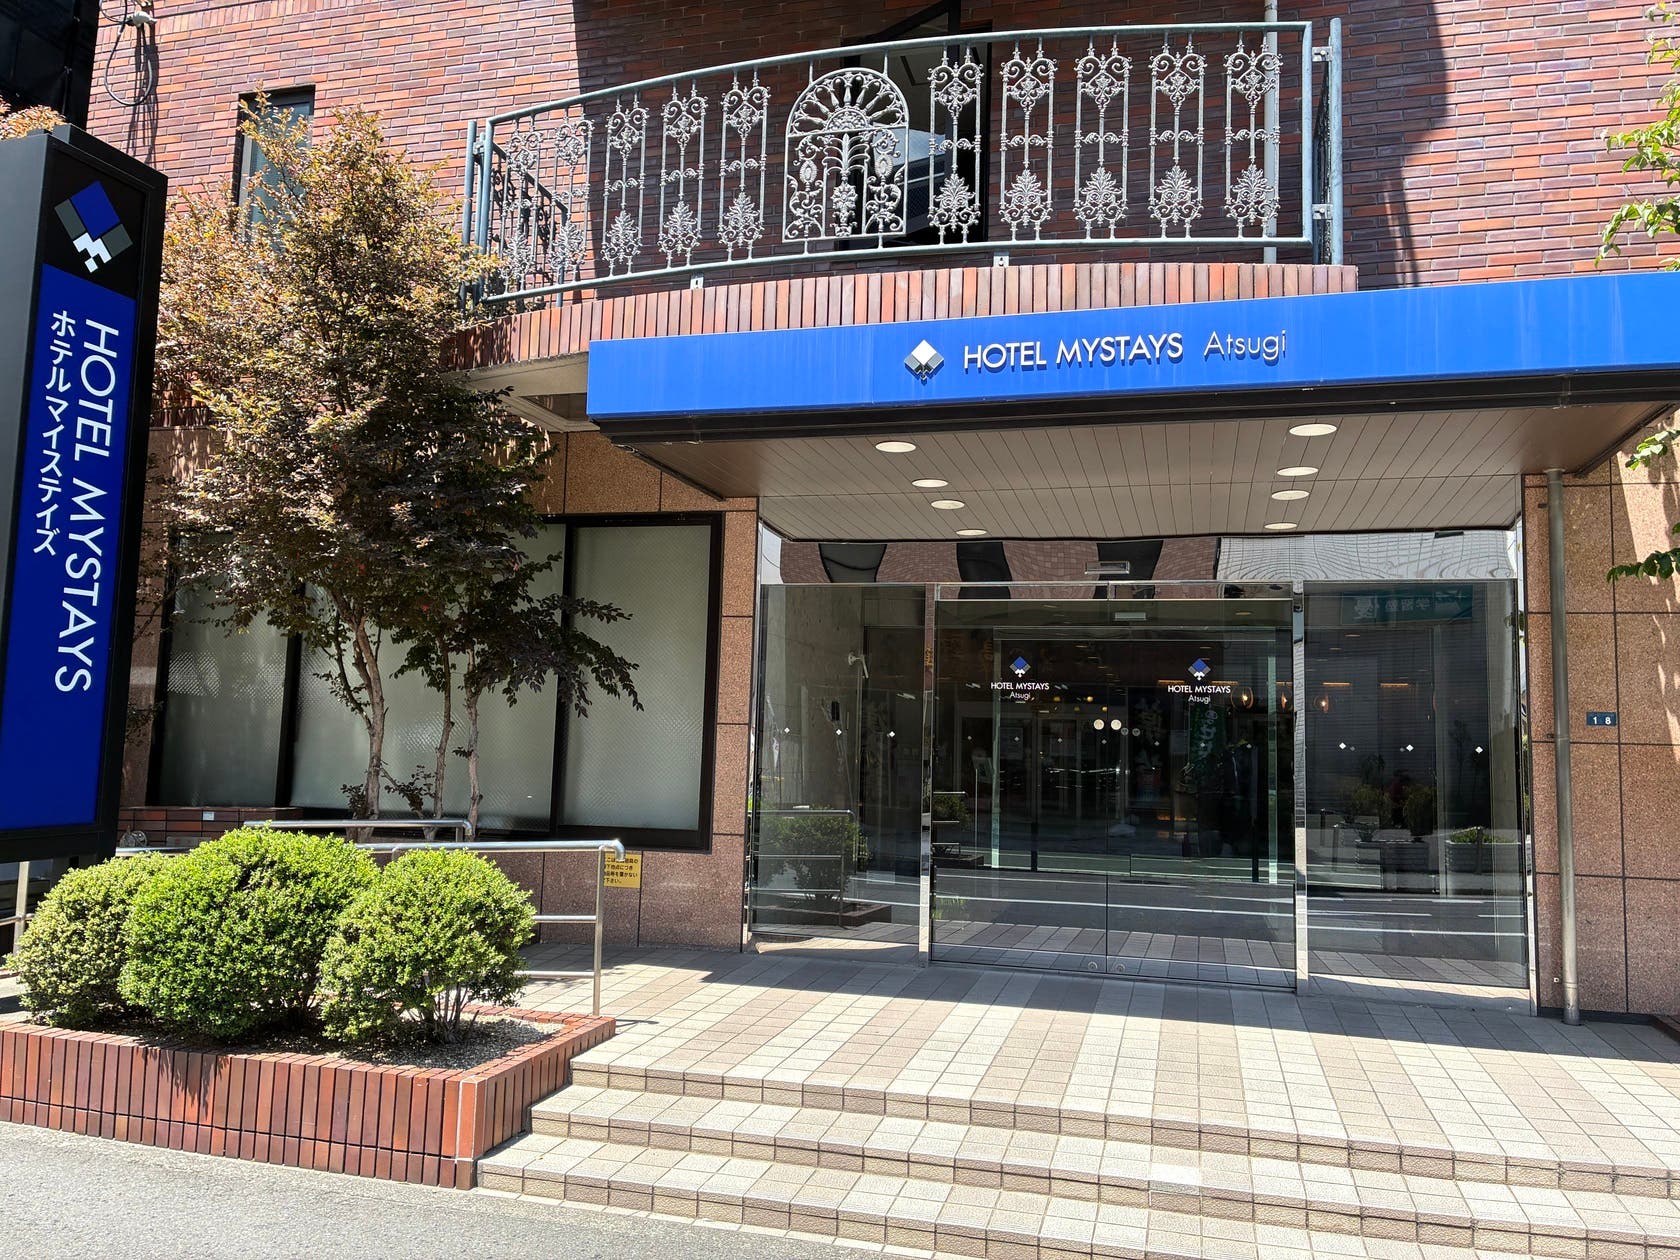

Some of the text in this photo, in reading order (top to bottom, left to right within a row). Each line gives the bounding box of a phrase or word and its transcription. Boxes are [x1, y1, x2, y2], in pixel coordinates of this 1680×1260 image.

[963, 329, 1287, 370] HOTEL MYSTAYS Atsugi
[33, 310, 77, 558] ホテルマイステイズ
[54, 318, 120, 693] HOTEL MYSTAYS
[990, 681, 1050, 691] HOTEL MYSTAYS
[1167, 684, 1231, 695] HOTEL MYSTAYS
[1009, 691, 1031, 701] Atsugi
[1188, 694, 1212, 705] Atsugi
